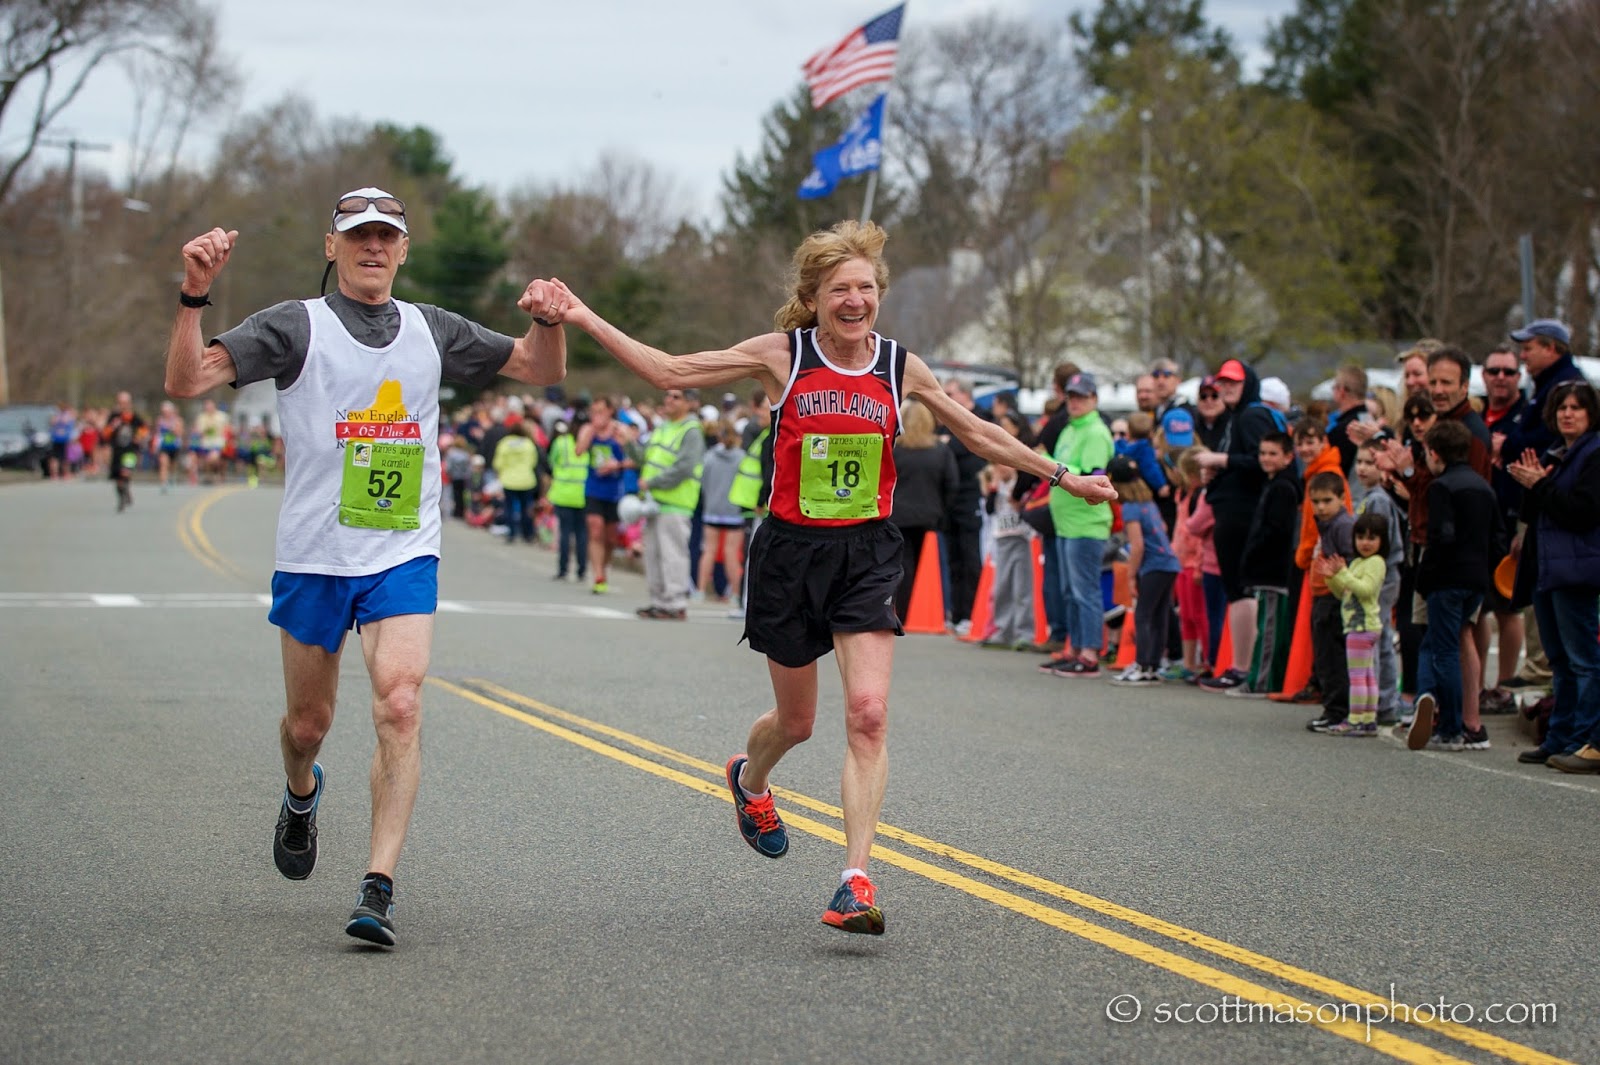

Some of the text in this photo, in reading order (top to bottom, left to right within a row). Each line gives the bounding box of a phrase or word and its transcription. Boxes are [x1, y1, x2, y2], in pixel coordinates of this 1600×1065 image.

[335, 409, 420, 424] New England
[358, 425, 405, 437] 65 Plus
[367, 469, 402, 499] 52
[827, 460, 860, 488] 18
